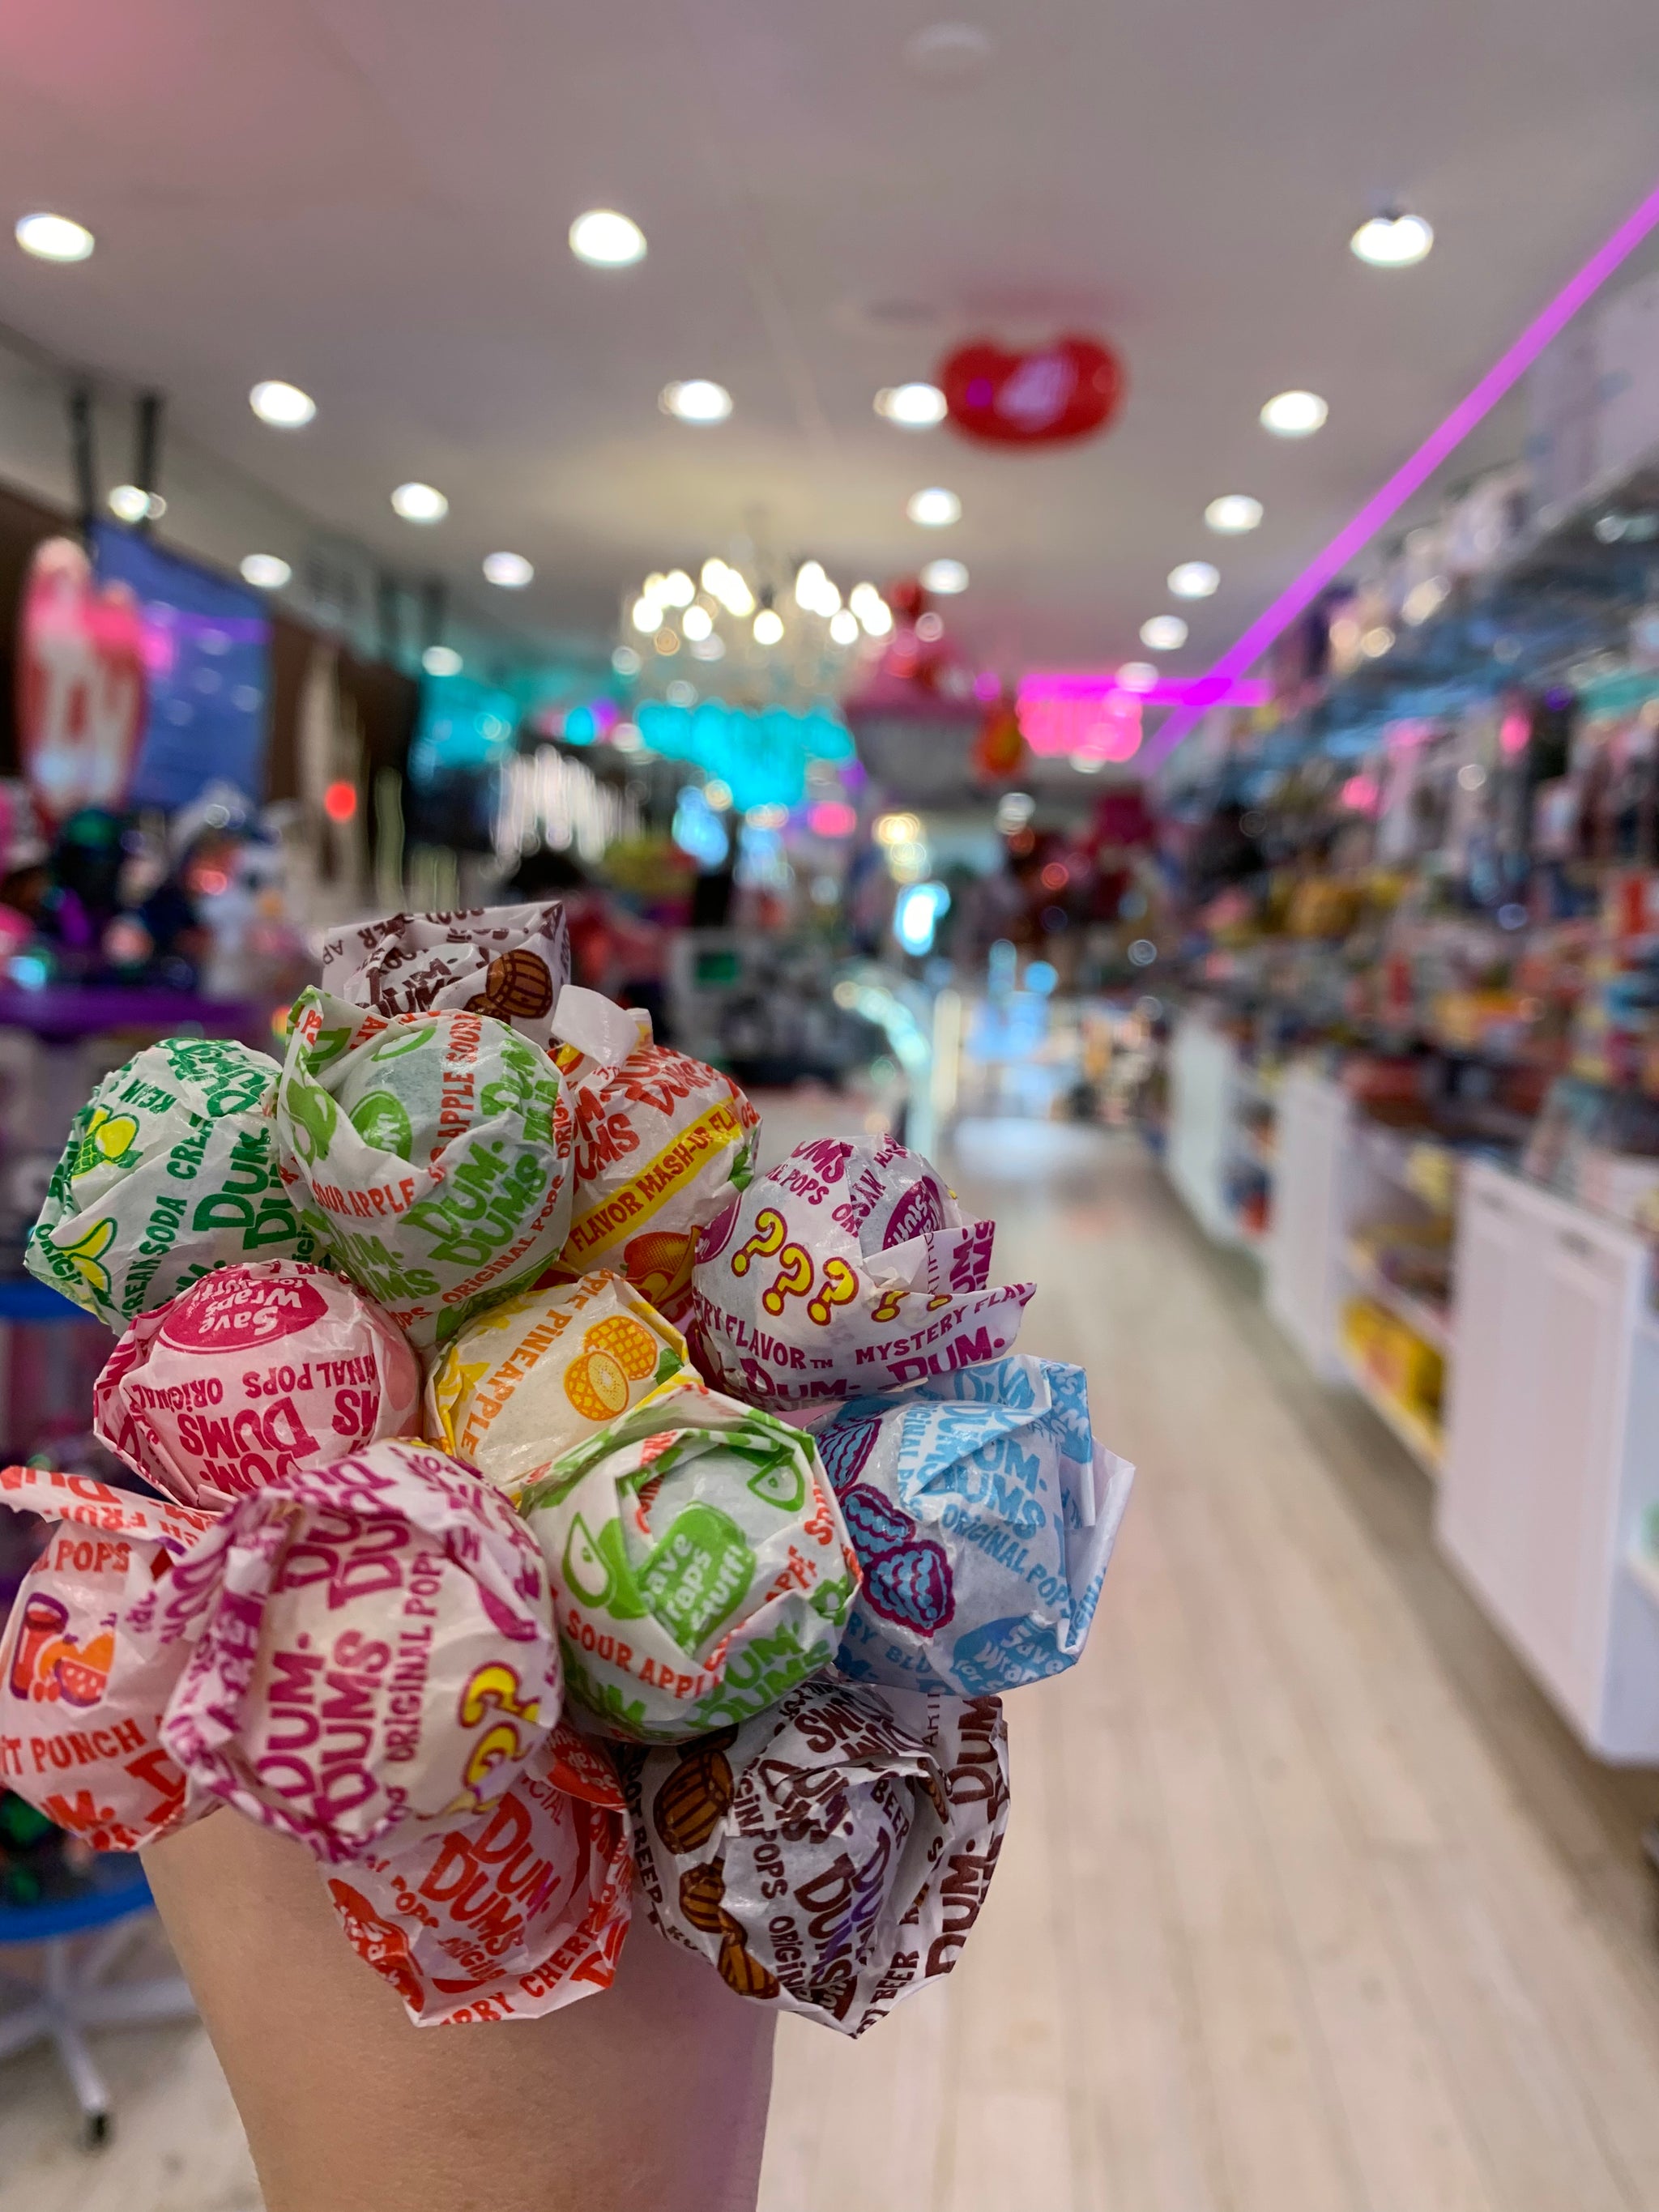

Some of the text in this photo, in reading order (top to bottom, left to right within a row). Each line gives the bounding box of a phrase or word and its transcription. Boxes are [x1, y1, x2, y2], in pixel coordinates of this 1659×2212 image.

[348, 1177, 416, 1218] APPLE
[398, 1140, 510, 1245] DUM.
[427, 1153, 548, 1268] DUMS
[529, 1174, 565, 1233] POPS
[569, 1191, 644, 1252] FLAVOR
[636, 1126, 714, 1202] MASH-UP
[783, 1166, 831, 1206] POPS
[139, 1196, 187, 1255] SODA
[198, 1305, 279, 1336] Save
[203, 1287, 303, 1315] Wraps
[726, 1314, 807, 1370] FLAVOR
[855, 1304, 968, 1366] MYSTERY
[887, 1325, 1005, 1385] DUM.
[242, 1362, 314, 1399] POPS
[177, 1396, 322, 1460] DUMS
[56, 1539, 133, 1574] POPS
[566, 1609, 634, 1673] SOUR
[257, 1631, 326, 1799] DUM.
[313, 1629, 392, 1827] DUMS
[30, 1717, 148, 1775] PUNCH
[869, 1775, 910, 1851] BEER
